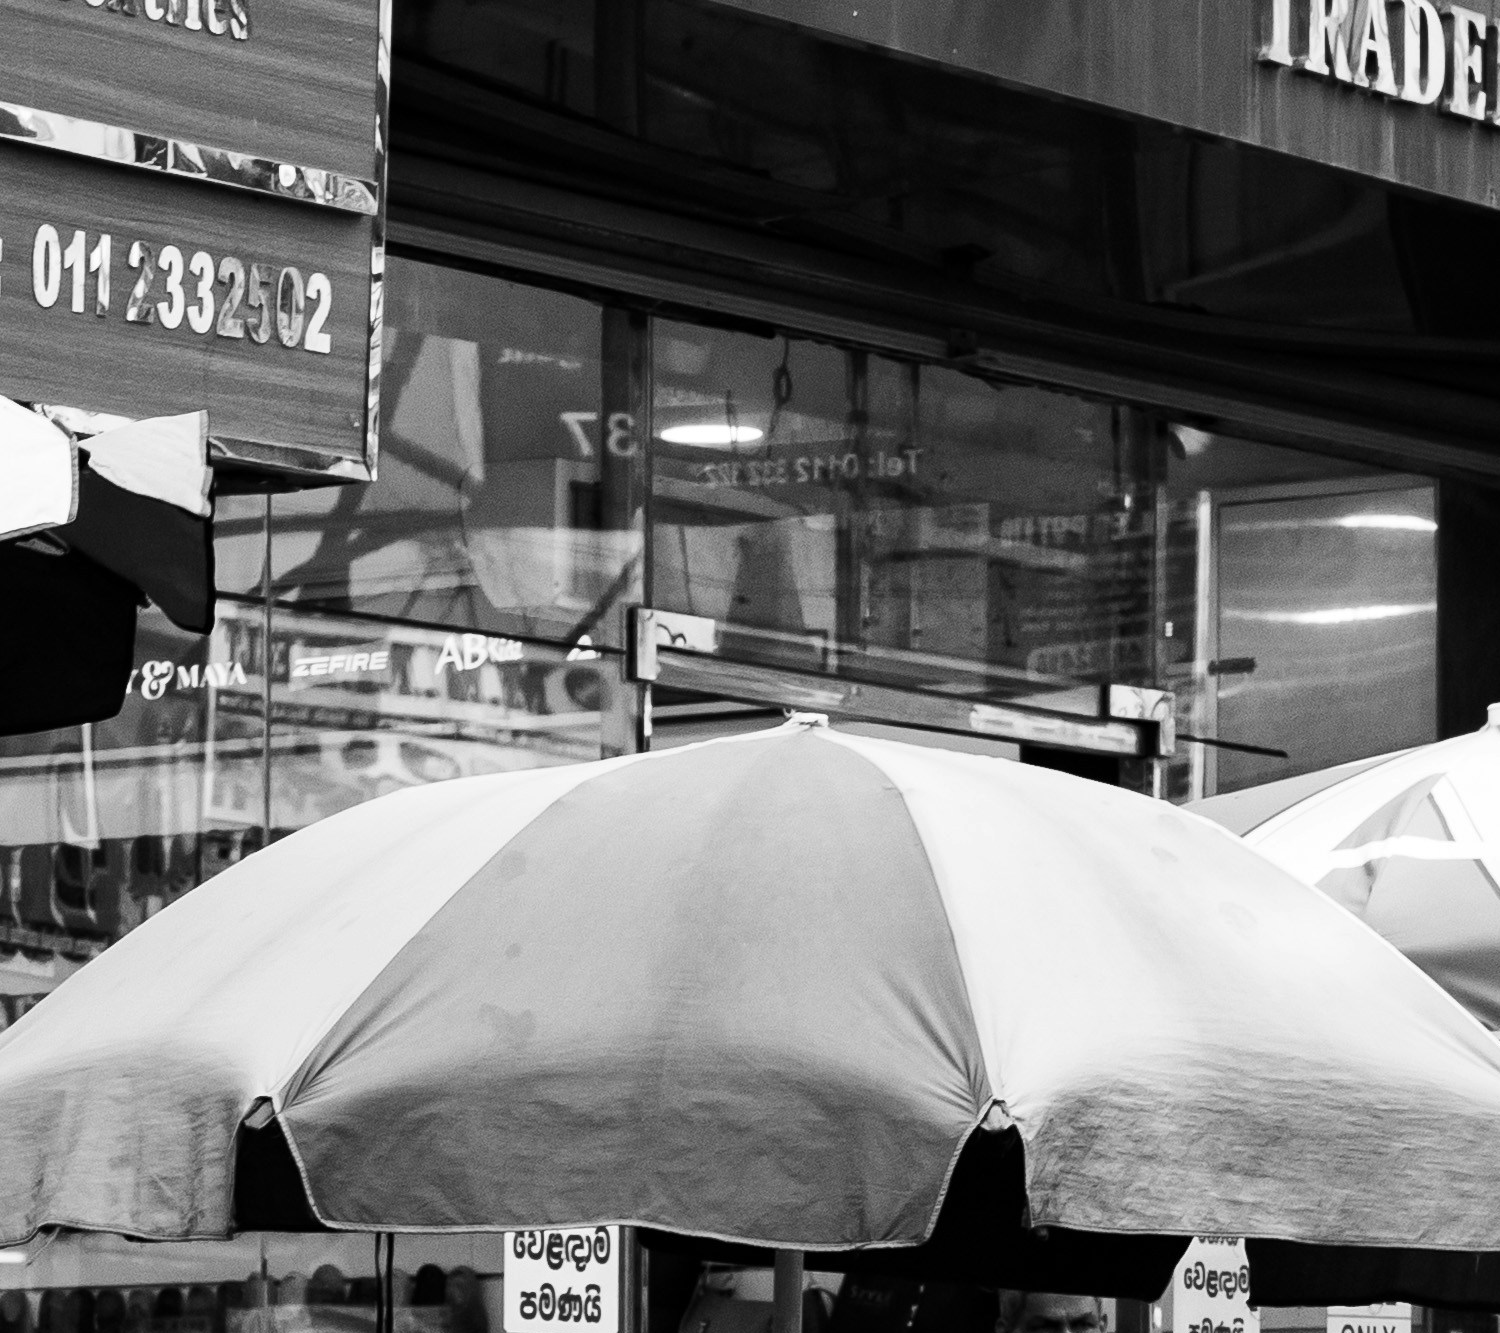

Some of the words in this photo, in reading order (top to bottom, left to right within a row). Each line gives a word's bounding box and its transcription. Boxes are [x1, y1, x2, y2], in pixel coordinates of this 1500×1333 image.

[32, 223, 111, 316] 011
[127, 239, 332, 354] 2332502
[176, 662, 247, 690] MAYA
[293, 651, 390, 678] ZEFIRE
[520, 1283, 601, 1323] පමණයි
